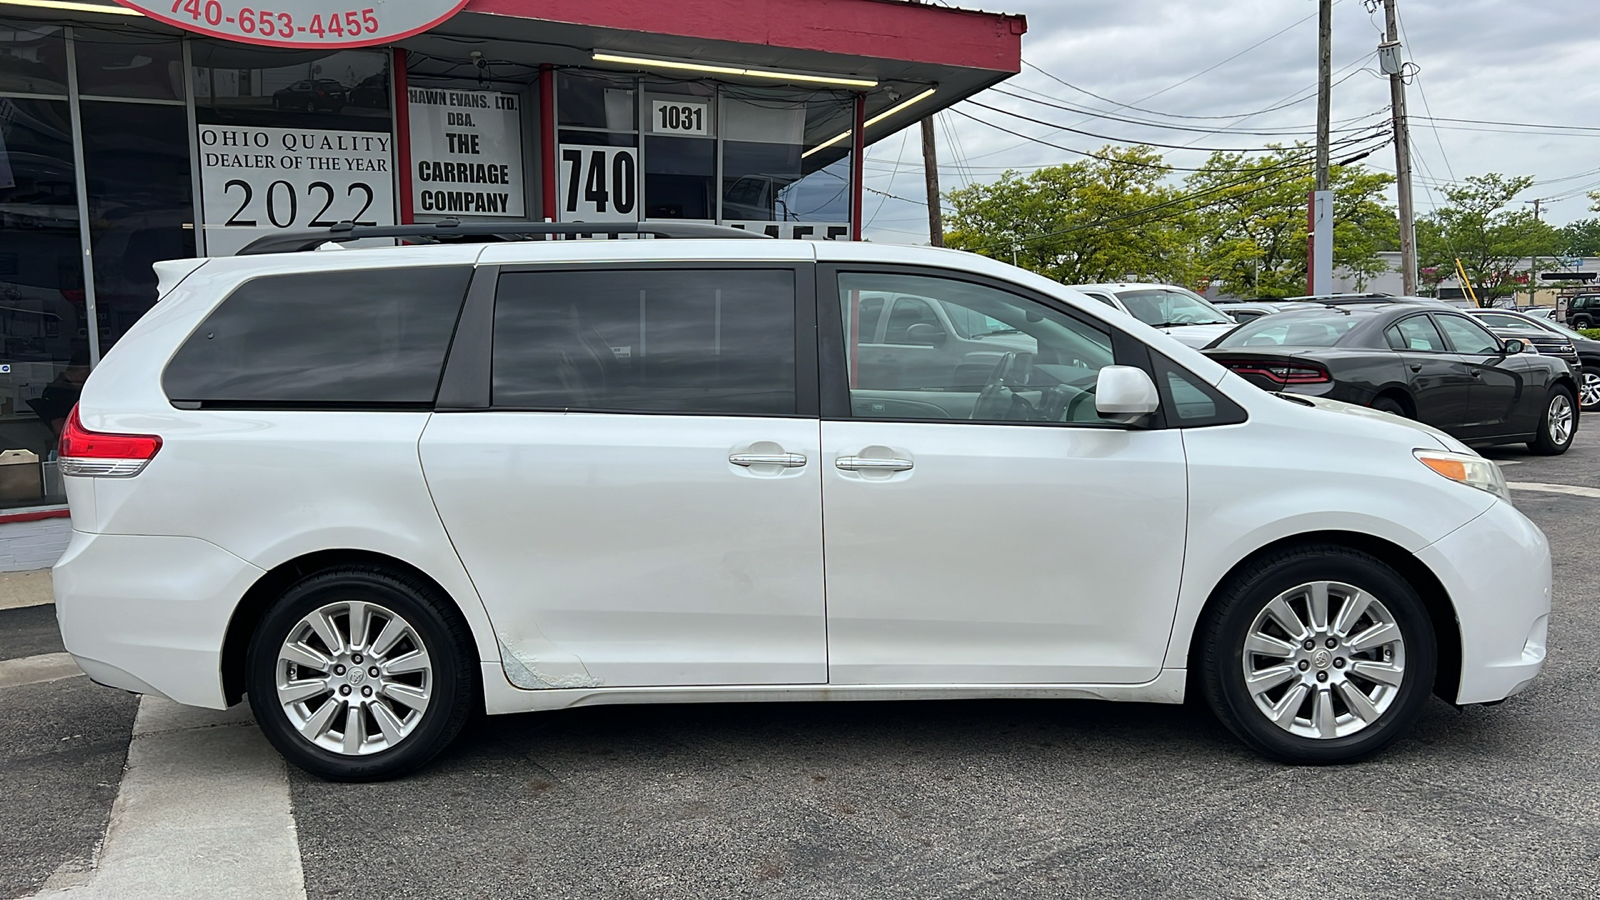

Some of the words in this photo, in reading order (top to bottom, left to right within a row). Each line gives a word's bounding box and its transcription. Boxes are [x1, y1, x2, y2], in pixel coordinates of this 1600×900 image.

[408, 89, 447, 106] HAWN
[495, 95, 518, 111] LTD.
[447, 112, 476, 127] DBA.
[658, 105, 702, 131] 1031
[201, 129, 269, 148] OHIO
[282, 133, 389, 152] QUALITY
[446, 133, 480, 154] THE
[205, 152, 276, 169] DEALER
[280, 155, 302, 170] OF
[307, 156, 341, 171] THE
[345, 157, 388, 172] YEAR
[418, 160, 509, 185] CARRIAGE
[562, 149, 635, 214] 740
[224, 179, 377, 229] 2022
[421, 190, 509, 213] COMPANY
